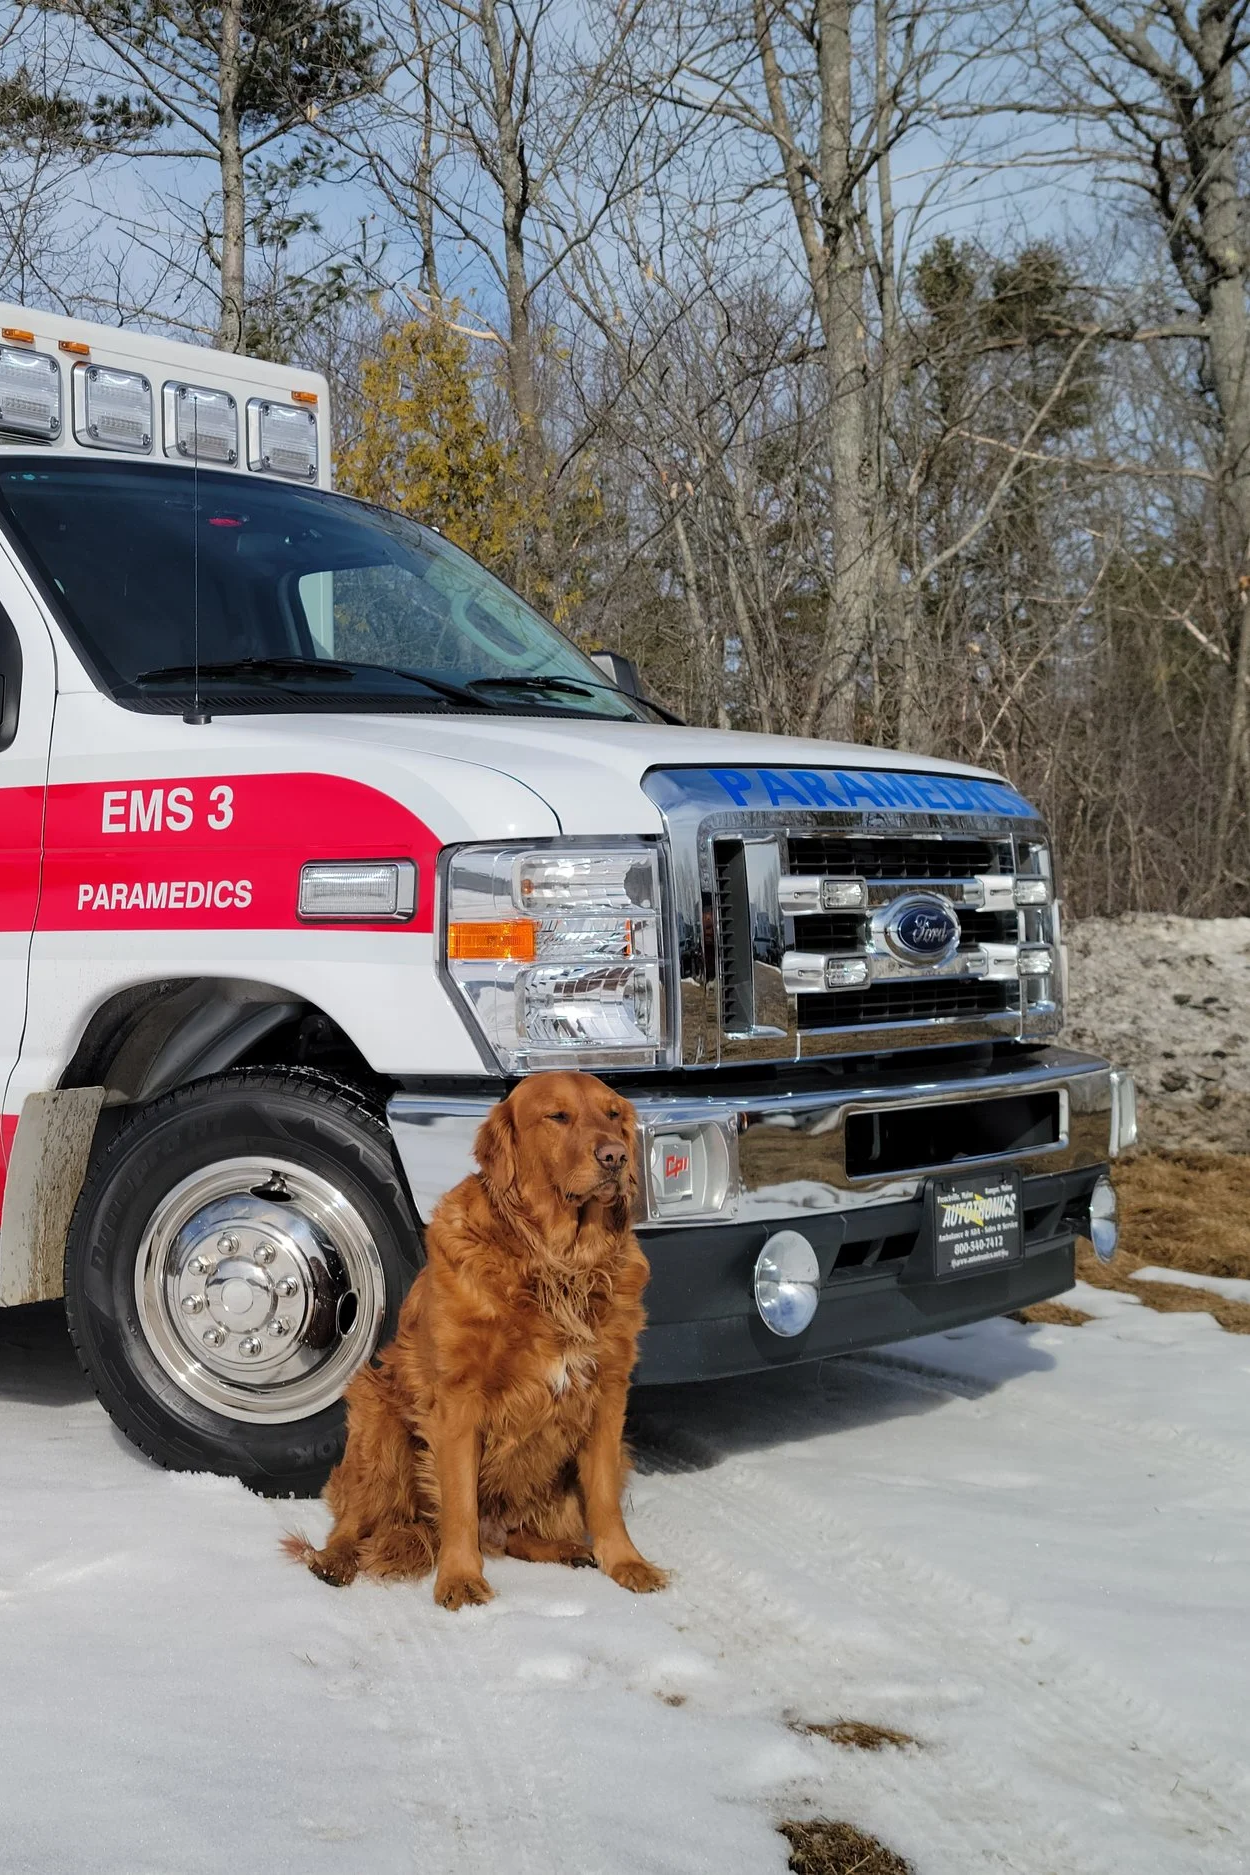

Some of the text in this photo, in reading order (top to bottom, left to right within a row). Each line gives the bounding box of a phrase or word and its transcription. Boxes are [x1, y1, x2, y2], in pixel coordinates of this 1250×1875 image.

[101, 785, 234, 833] EMS 3
[710, 769, 1031, 817] PARAMEDICS
[78, 880, 252, 910] PARAMEDICS
[912, 914, 948, 943] Ford
[942, 1193, 1017, 1228] AUTOTRONICS
